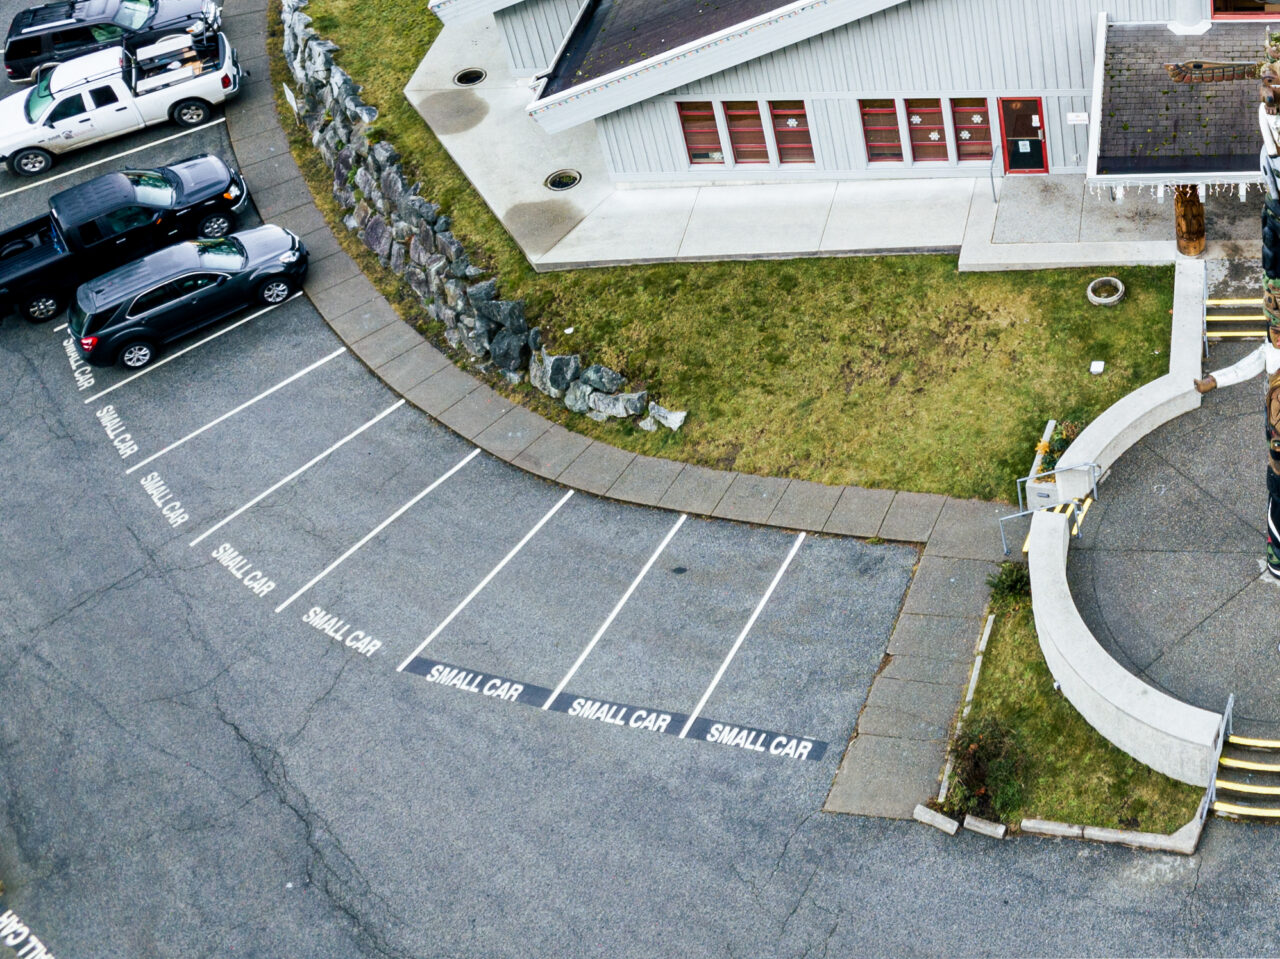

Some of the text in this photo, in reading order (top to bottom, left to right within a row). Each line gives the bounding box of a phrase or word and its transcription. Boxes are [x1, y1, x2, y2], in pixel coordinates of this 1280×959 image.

[74, 366, 95, 391] CAR
[96, 405, 139, 459] SMALL CAR
[140, 472, 189, 528] SMALL CAR
[211, 543, 276, 597] SMALL CAR
[302, 606, 382, 657] SMALL CAR
[425, 665, 525, 702] SMALL CAR
[568, 698, 672, 734] SMALL CAR
[706, 723, 814, 761] SMALL CAR
